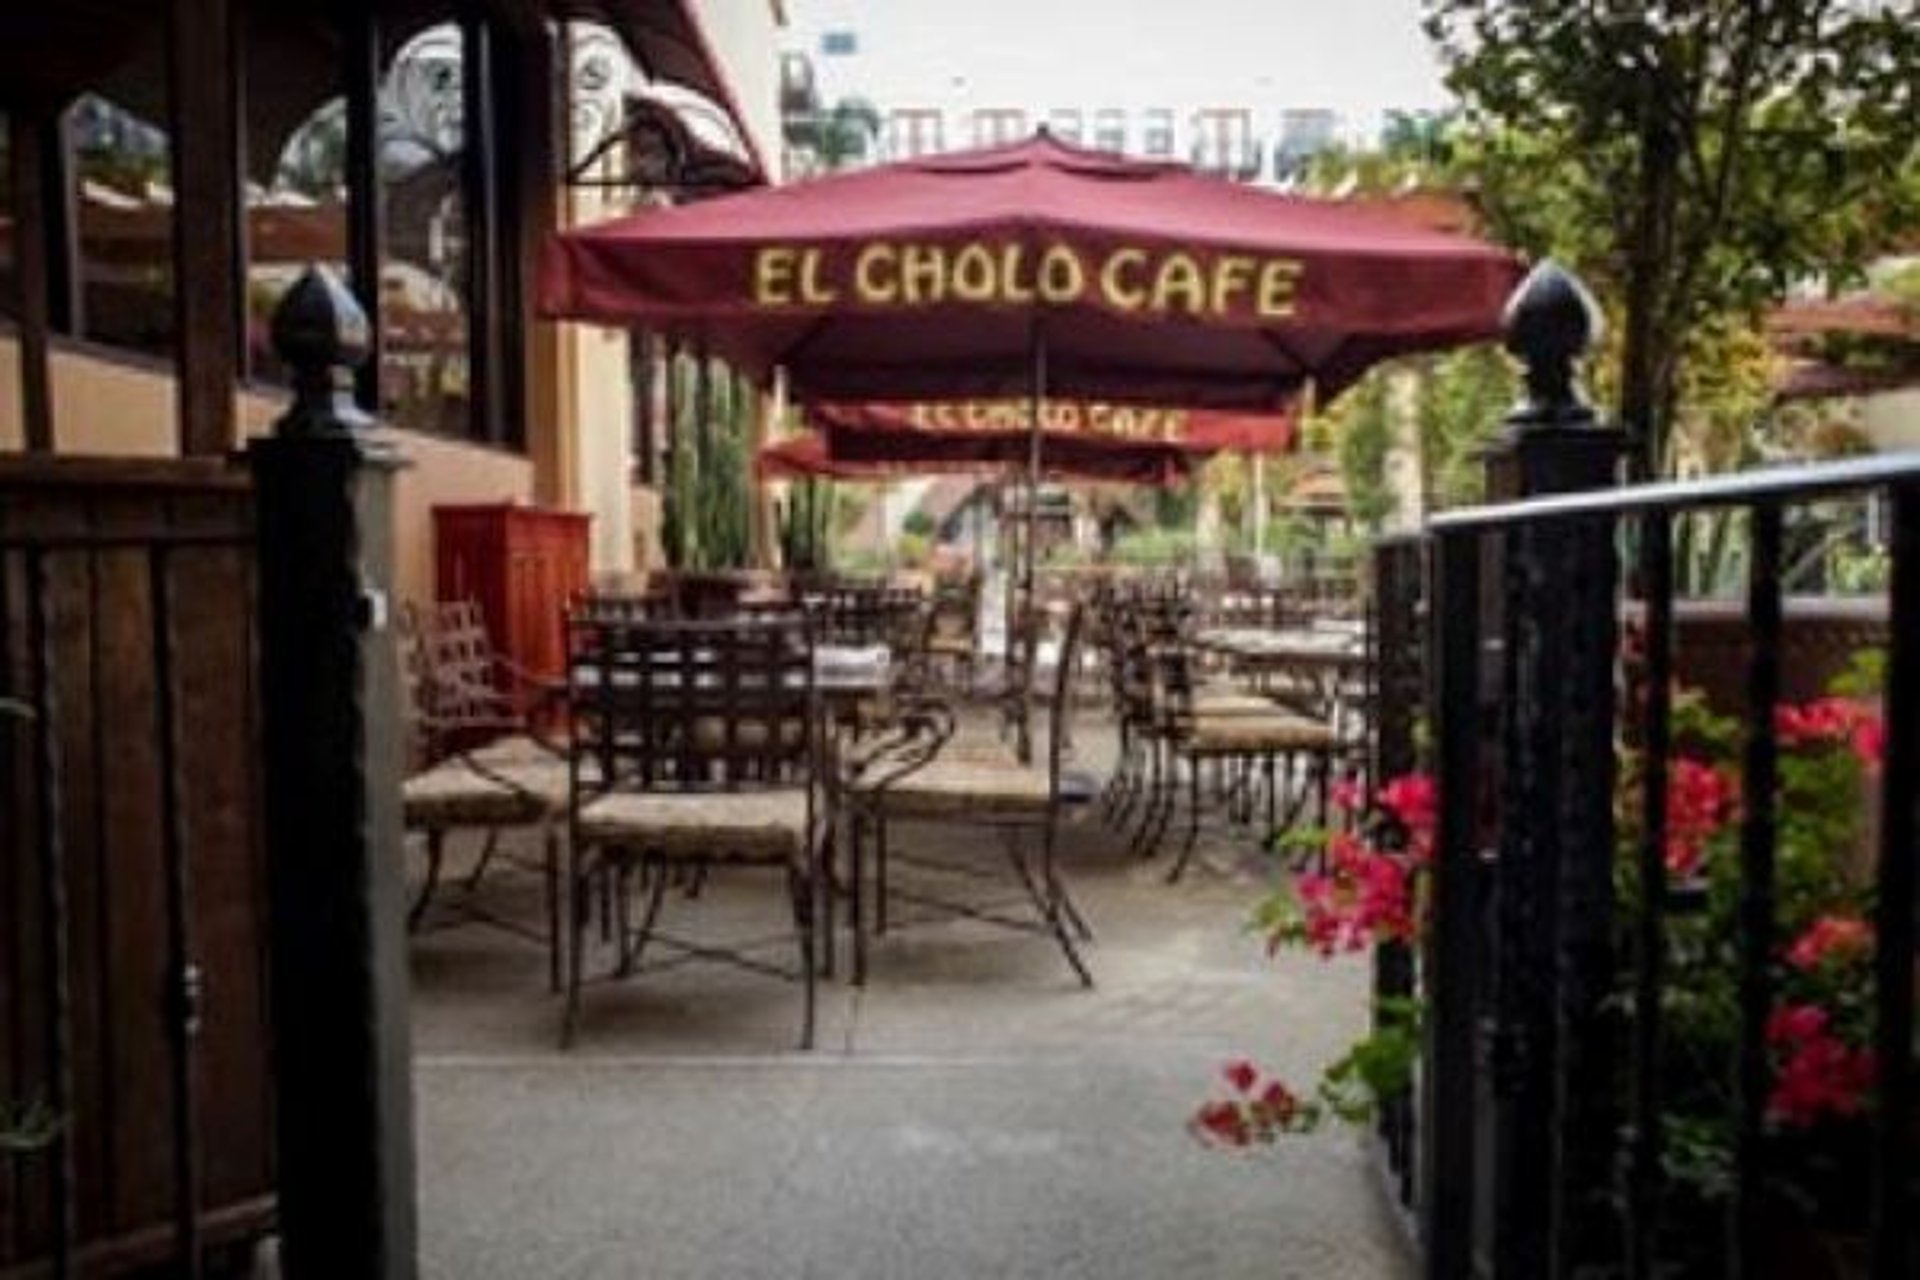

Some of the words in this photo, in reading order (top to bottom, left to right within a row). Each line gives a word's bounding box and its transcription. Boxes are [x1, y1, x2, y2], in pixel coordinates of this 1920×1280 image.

[757, 248, 834, 305] EL
[856, 243, 1083, 304] CHOLO
[1101, 249, 1303, 316] CAFE
